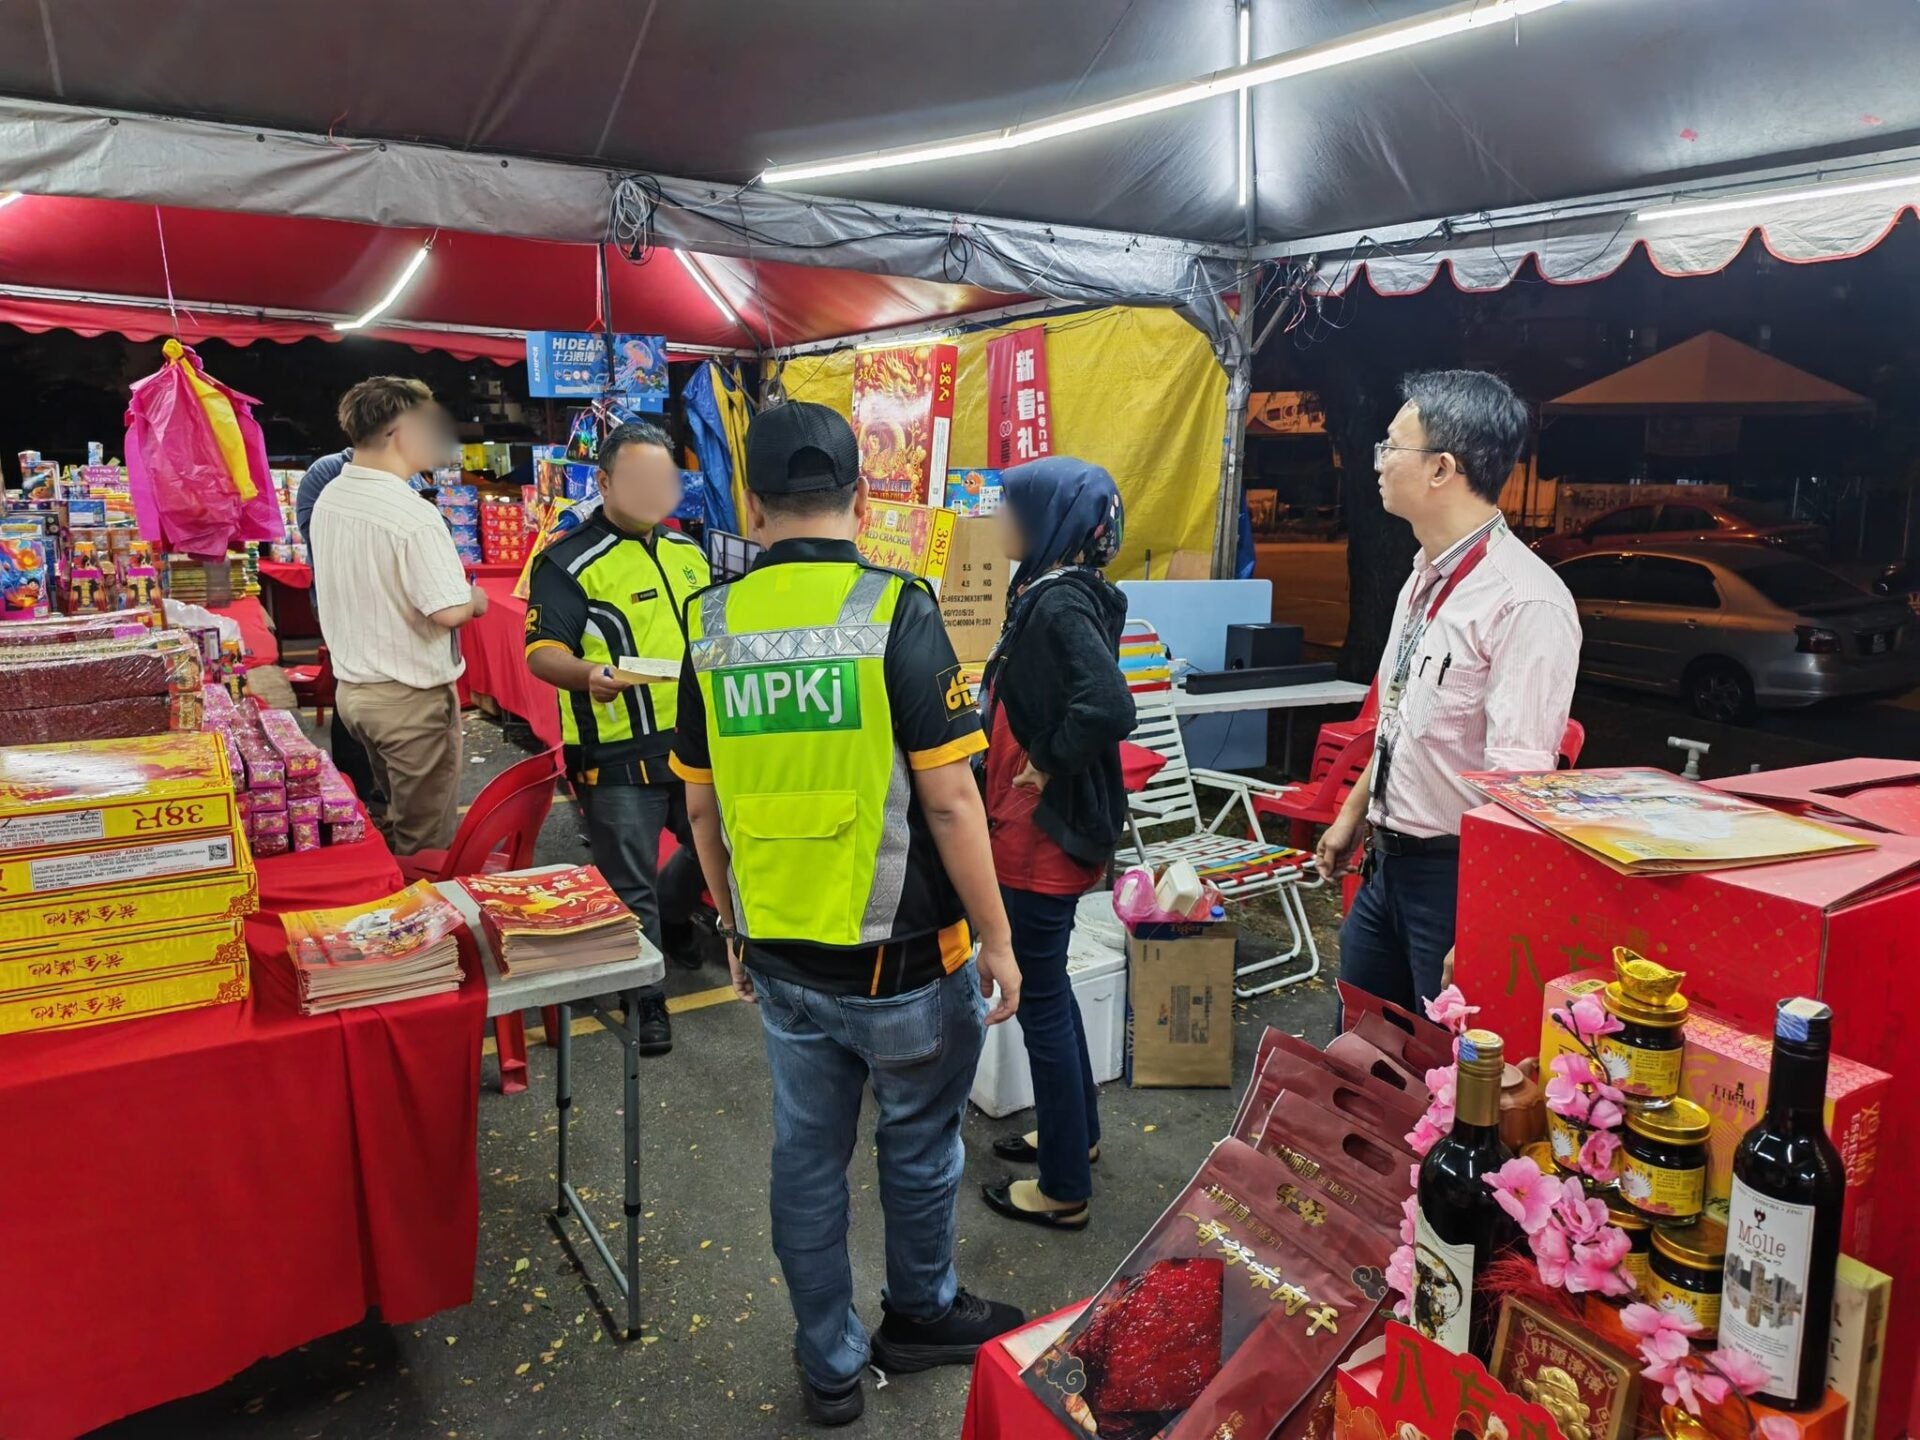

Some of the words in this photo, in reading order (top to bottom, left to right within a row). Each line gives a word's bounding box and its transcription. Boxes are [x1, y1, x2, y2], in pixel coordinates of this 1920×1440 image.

[553, 338, 566, 350] HI
[568, 339, 604, 351] DEAR
[1016, 348, 1038, 459] 新春礼
[931, 528, 949, 566] 38尺
[722, 666, 844, 724] MPKj
[1738, 1218, 1787, 1259] Molle
